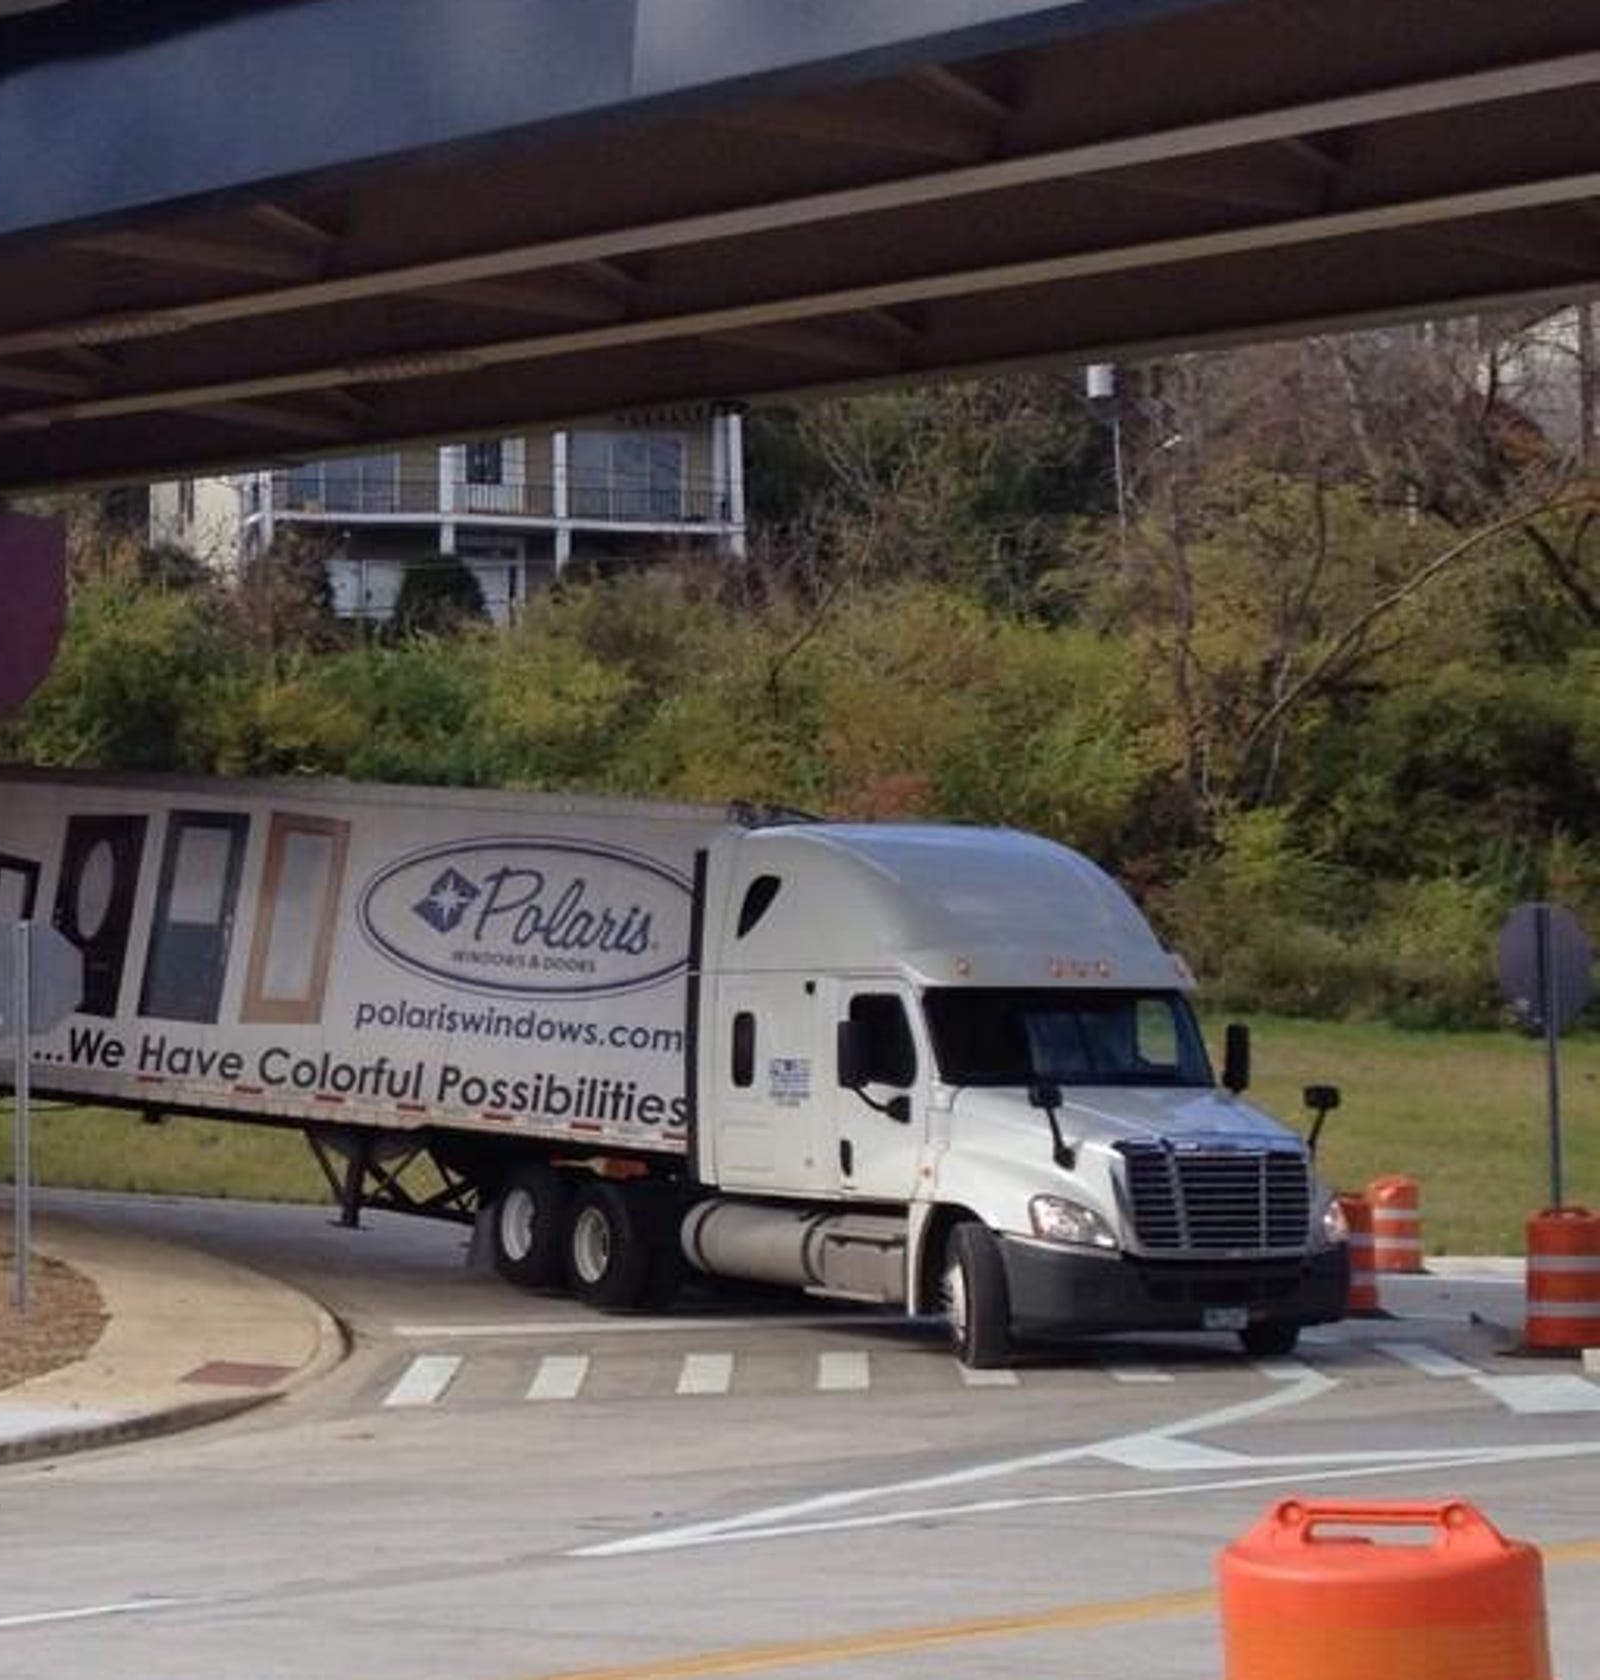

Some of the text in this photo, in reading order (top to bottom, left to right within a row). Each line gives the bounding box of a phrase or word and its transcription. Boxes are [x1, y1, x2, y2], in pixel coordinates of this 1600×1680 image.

[473, 866, 654, 956] Polaris
[451, 949, 525, 969] WINDOWS
[542, 955, 596, 974] DOORS
[355, 1000, 683, 1053] polariswindows.com
[137, 1034, 244, 1081] Have
[258, 1046, 424, 1101] Colorful
[437, 1065, 690, 1128] Possibilities
